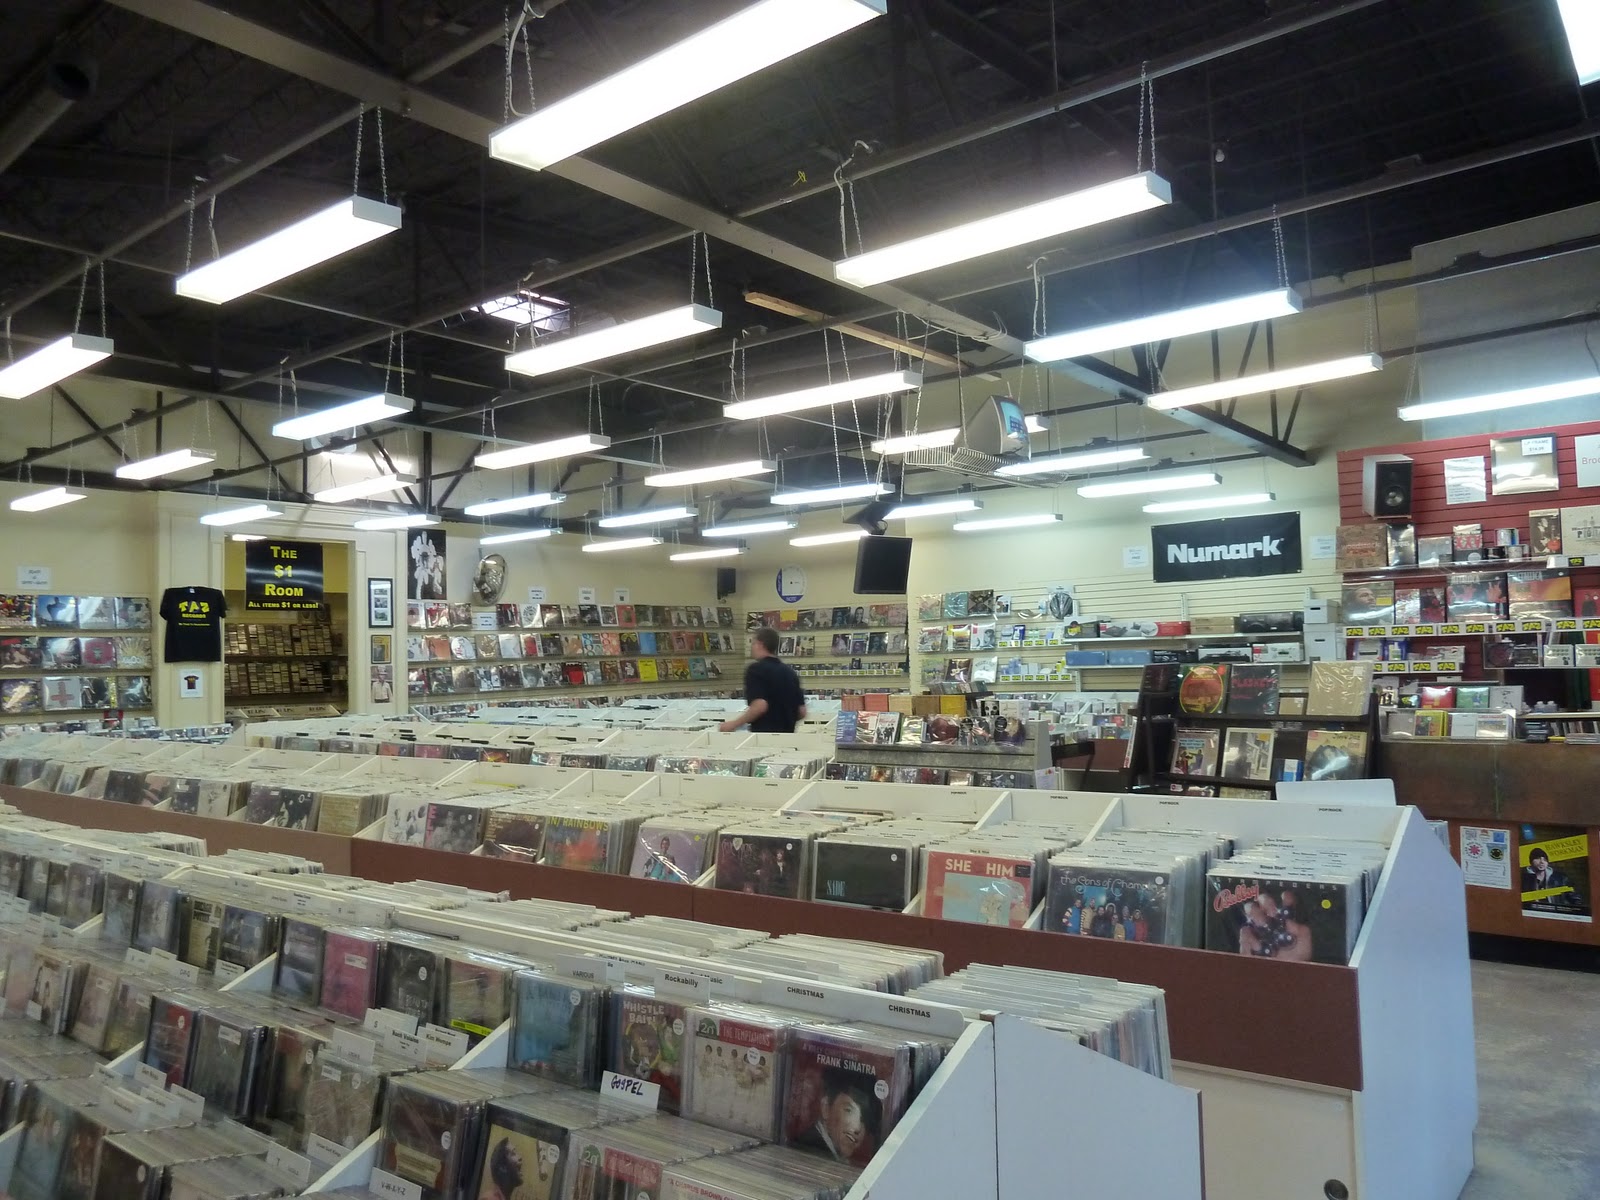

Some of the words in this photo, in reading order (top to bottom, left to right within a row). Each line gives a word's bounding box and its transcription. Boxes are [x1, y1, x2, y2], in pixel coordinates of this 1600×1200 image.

[1167, 535, 1282, 564] Numark
[274, 564, 293, 578] $1
[179, 601, 210, 613] TAZ
[281, 601, 291, 609] $1
[562, 817, 609, 832] RAINBOWS
[945, 858, 972, 873] SHE
[986, 862, 1014, 878] HIM
[572, 970, 595, 979] VARIOUS
[664, 973, 699, 988] Rockabilly
[787, 986, 825, 999] CHRISTMAS
[623, 1000, 665, 1015] WHISTLE
[888, 1004, 931, 1018] CHRISTMAS
[816, 1053, 841, 1068] FRANK
[843, 1059, 876, 1076] SINATRA
[611, 1075, 643, 1096] GOSPEL
